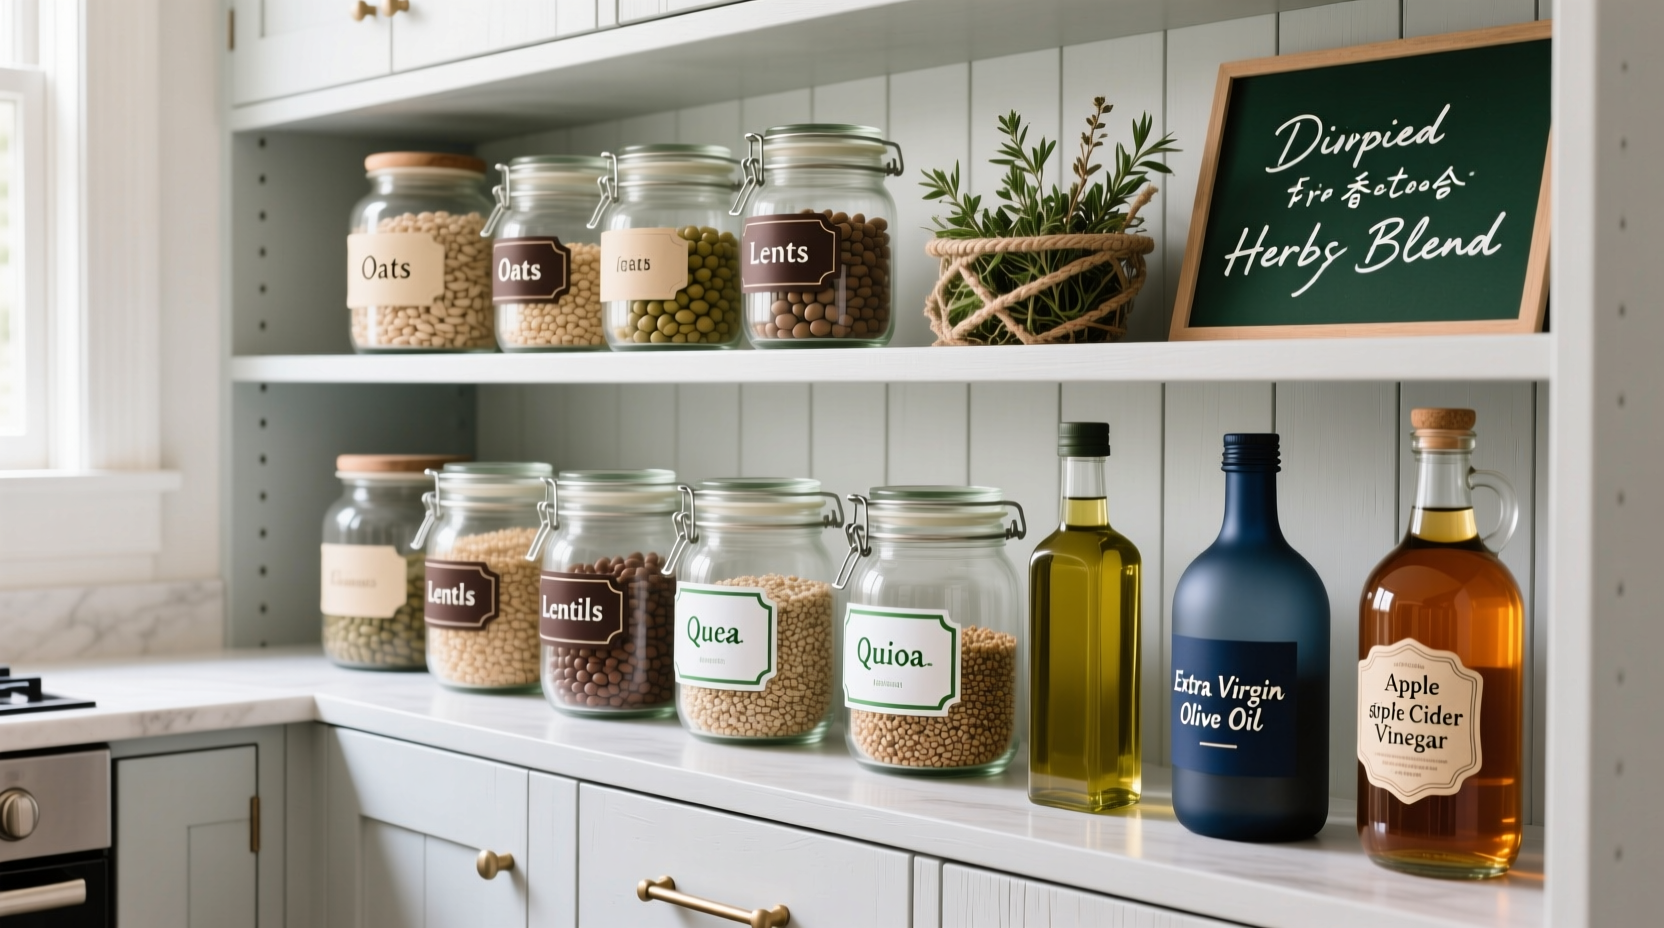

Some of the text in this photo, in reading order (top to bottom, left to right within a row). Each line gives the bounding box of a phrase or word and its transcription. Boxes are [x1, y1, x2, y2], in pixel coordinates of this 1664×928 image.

[750, 241, 809, 264] Lents
[1355, 211, 1507, 274] Blend
[361, 255, 411, 280] Oats
[498, 257, 542, 282] Oats
[428, 580, 476, 606] Lentls
[542, 594, 603, 622] Lentils
[1173, 669, 1286, 708] Extra Virgin
[1384, 673, 1440, 700] Apple
[1180, 701, 1264, 732] Olive Oil
[1409, 704, 1464, 726] Cider
[1375, 723, 1448, 753] Vinegar
